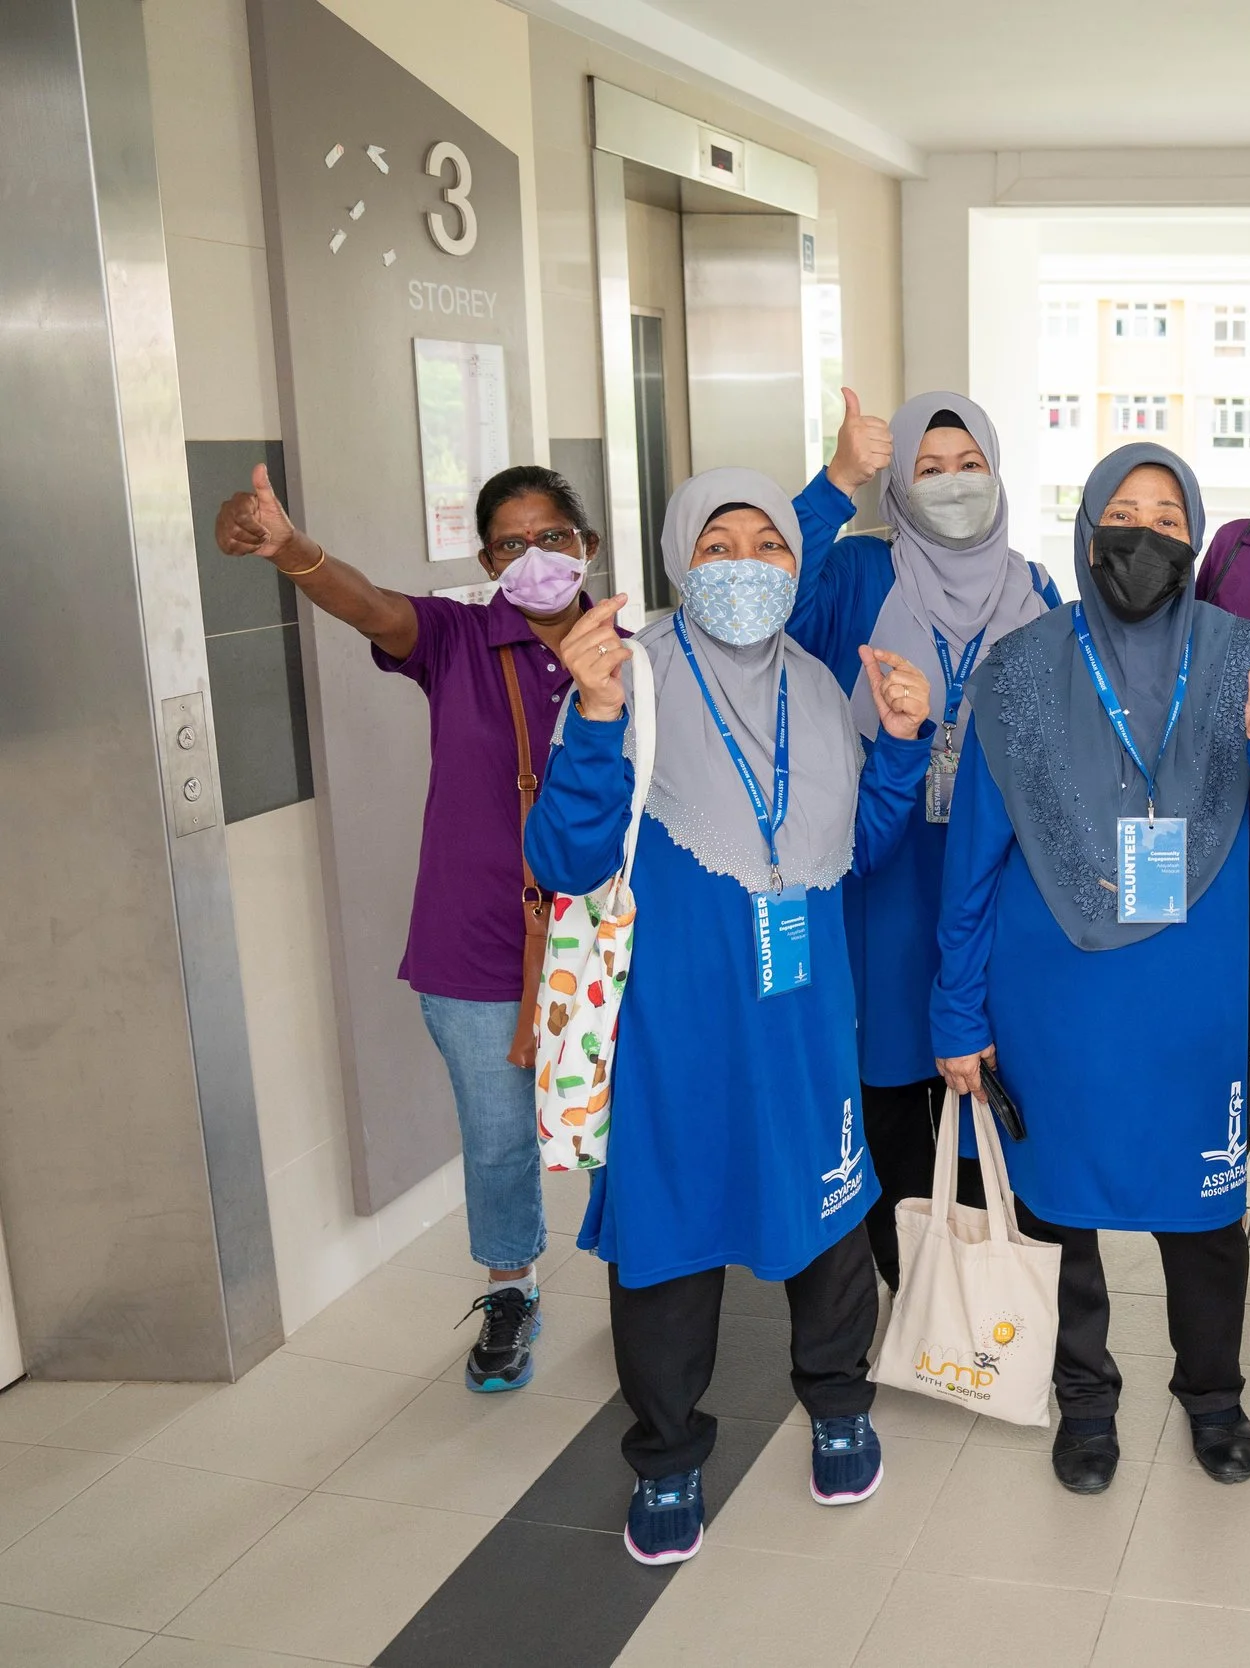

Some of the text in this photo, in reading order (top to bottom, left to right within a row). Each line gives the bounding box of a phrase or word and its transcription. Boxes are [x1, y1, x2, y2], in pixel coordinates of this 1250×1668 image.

[425, 141, 478, 256] 3
[408, 279, 497, 319] STOREY
[1124, 824, 1136, 917] VOLUNTEER
[757, 896, 773, 993] VOLUNTEER
[821, 1200, 842, 1219] MOSQUE
[1201, 1184, 1229, 1198] MOSQUE
[915, 1371, 942, 1387] WITH
